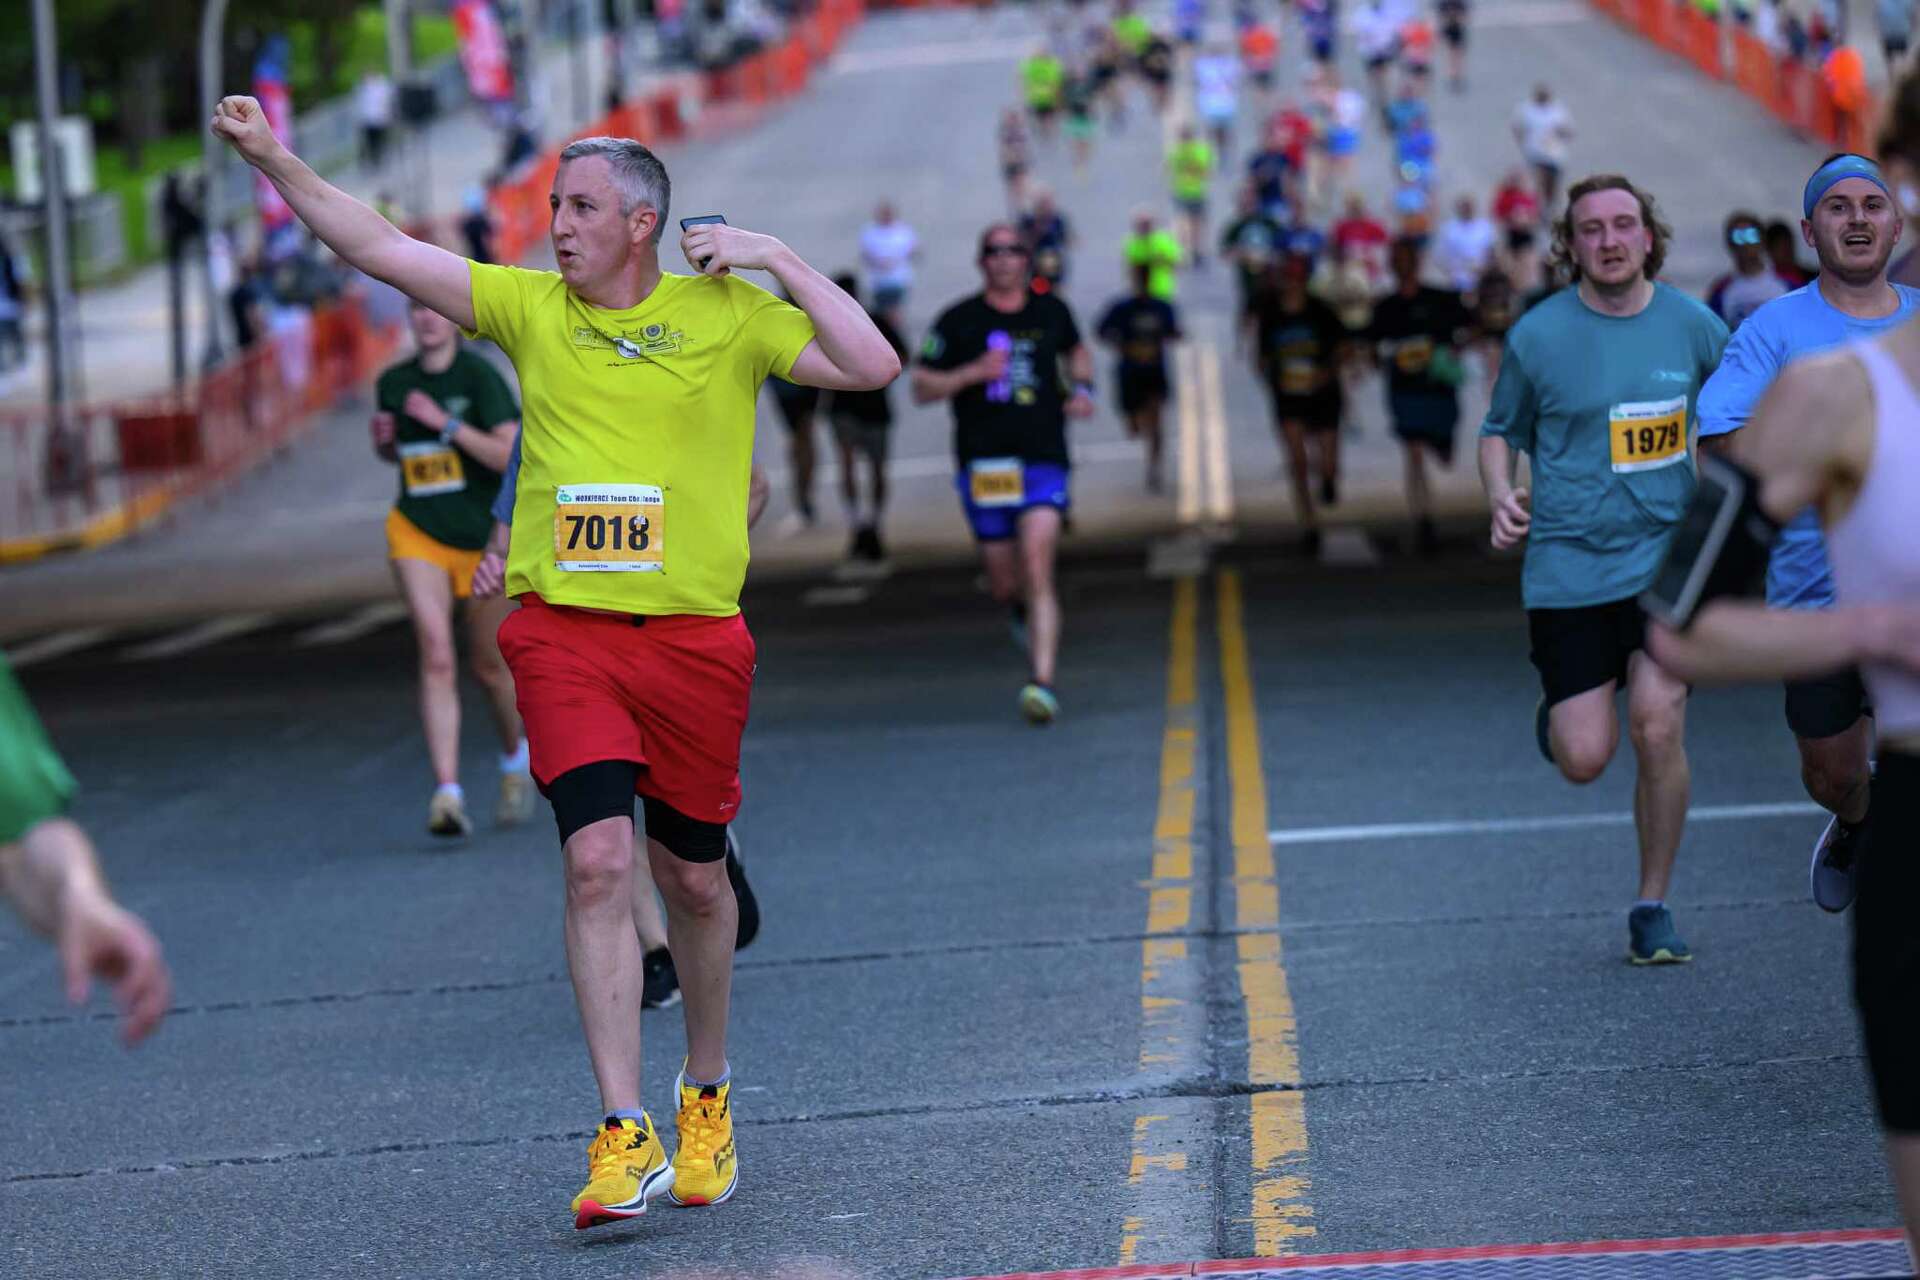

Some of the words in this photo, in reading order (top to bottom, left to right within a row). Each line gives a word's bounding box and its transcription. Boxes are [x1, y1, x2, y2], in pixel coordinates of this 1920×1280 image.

[1623, 421, 1679, 455] 1979
[575, 494, 609, 502] WORKFORCE
[565, 514, 650, 551] 7018
